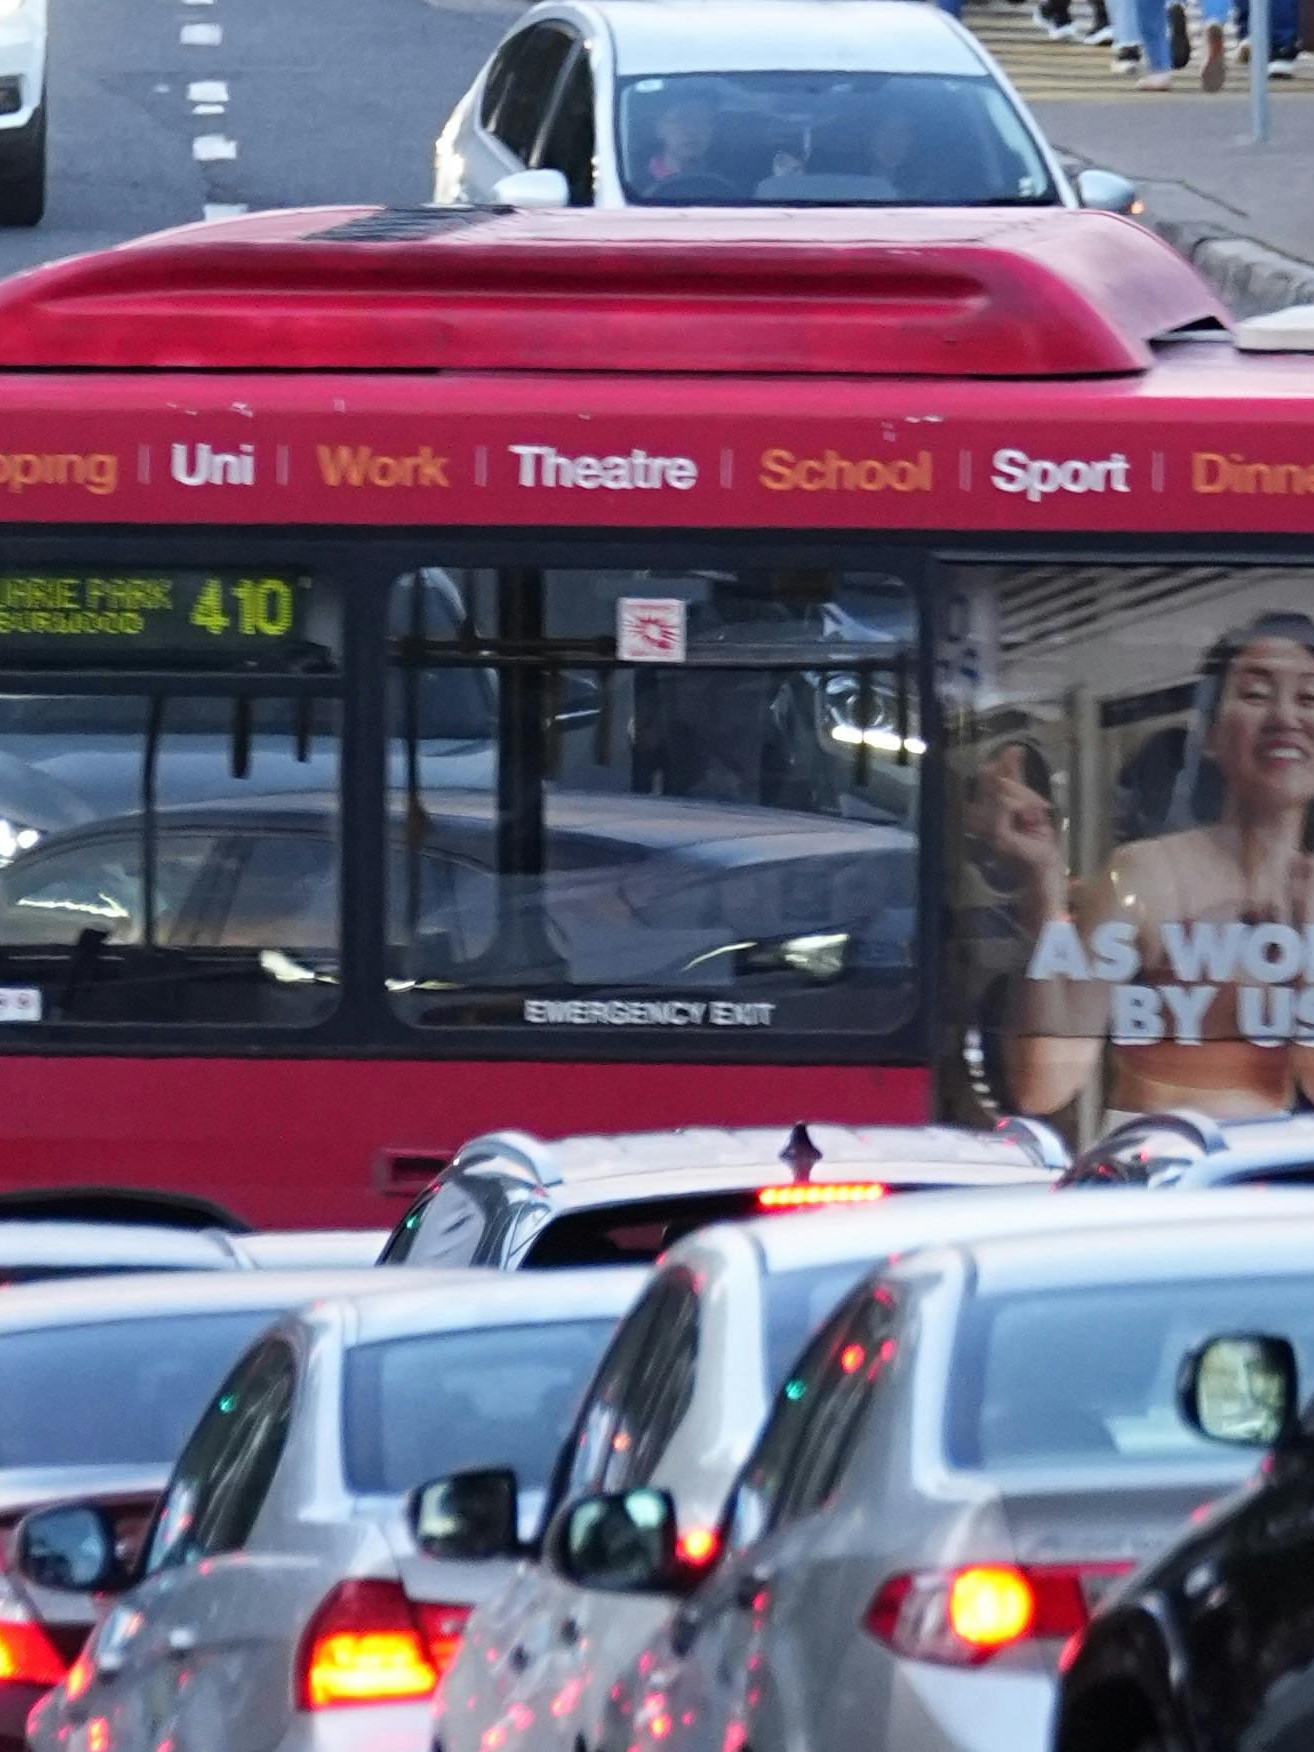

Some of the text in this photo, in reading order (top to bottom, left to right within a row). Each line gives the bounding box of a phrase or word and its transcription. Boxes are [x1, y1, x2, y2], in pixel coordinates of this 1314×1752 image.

[171, 442, 255, 488] Uni
[317, 444, 450, 488] Work
[508, 443, 698, 491] Theatre
[758, 449, 932, 493] School
[990, 448, 1131, 502] Sport
[189, 576, 294, 636] 410
[1026, 920, 1142, 983] AS
[523, 999, 777, 1027] EMERGENCY EXIT
[1110, 984, 1218, 1046] BY
